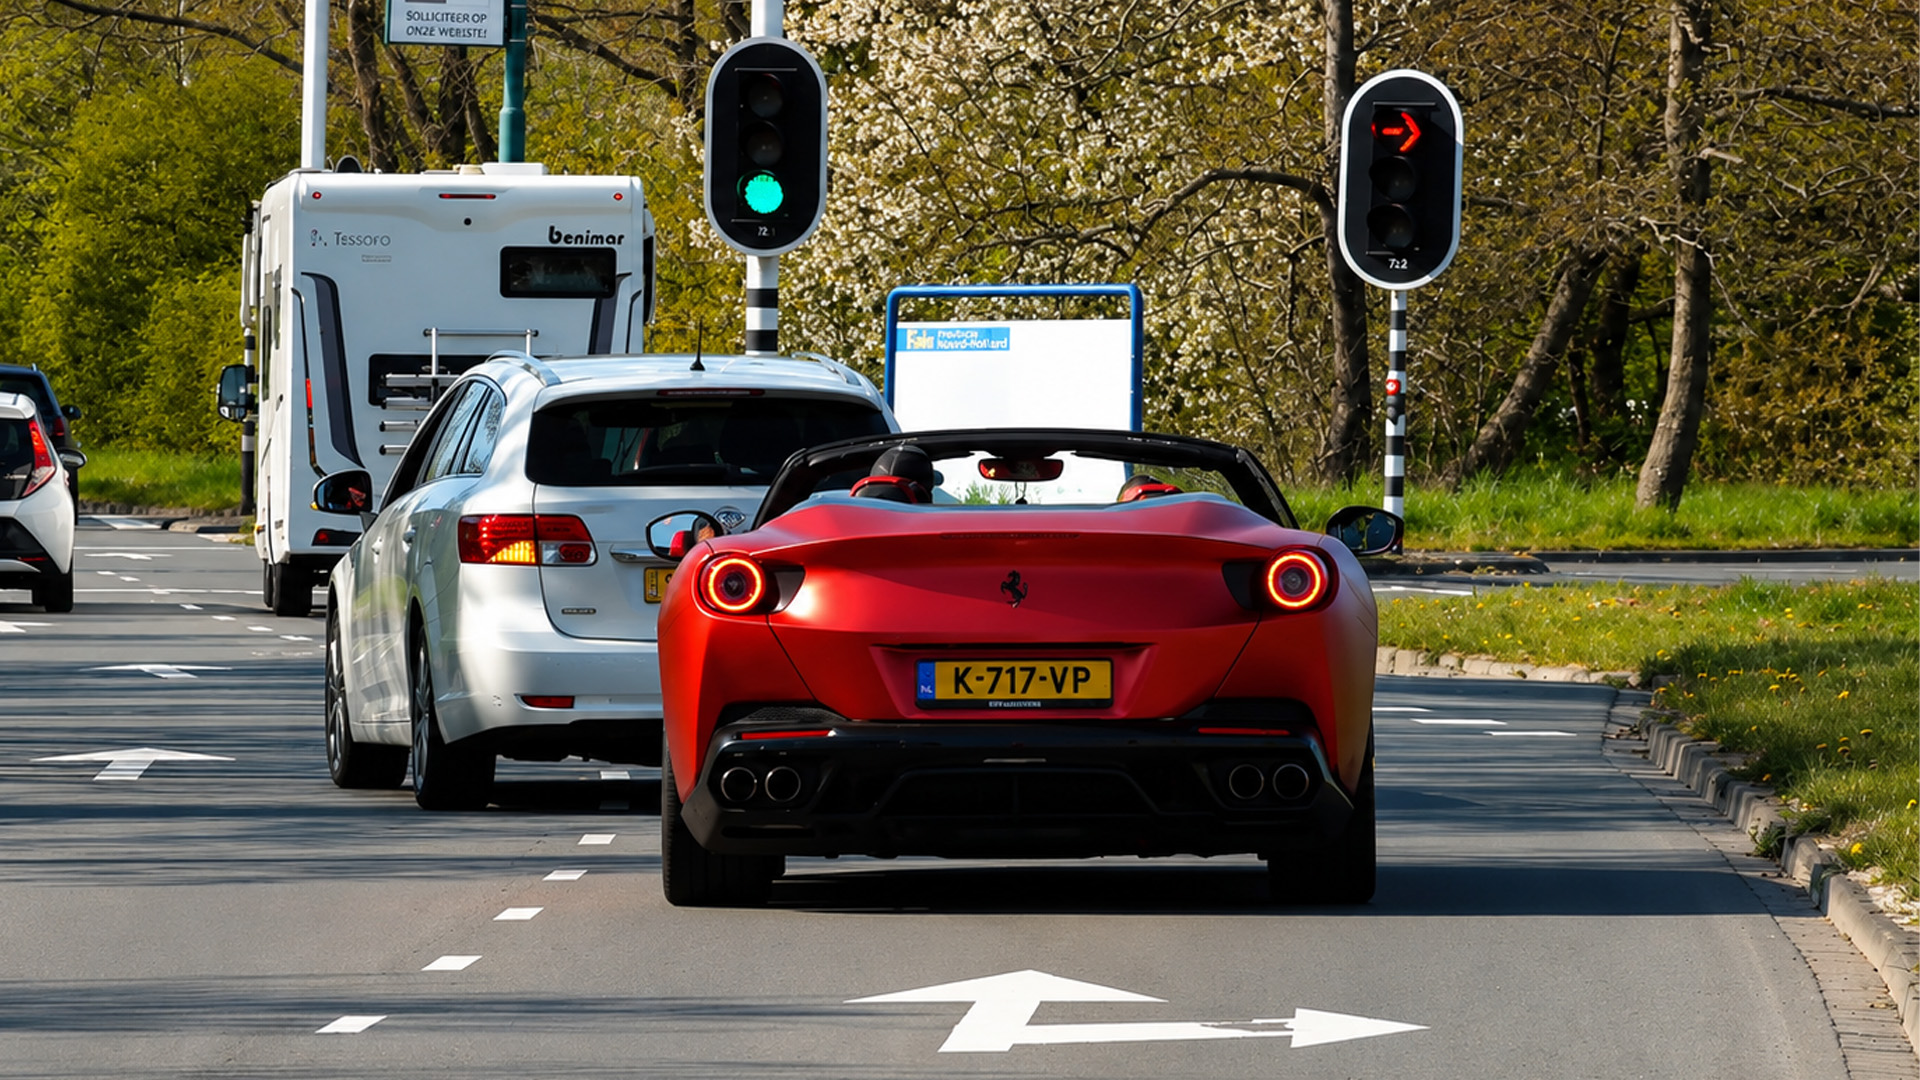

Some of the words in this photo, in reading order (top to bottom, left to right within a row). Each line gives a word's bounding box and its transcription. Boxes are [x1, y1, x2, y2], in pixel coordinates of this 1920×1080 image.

[406, 10, 469, 23] SOLLICITEER
[471, 13, 487, 23] OP
[548, 225, 625, 245] benimar
[954, 666, 1091, 694] K-717-VP
